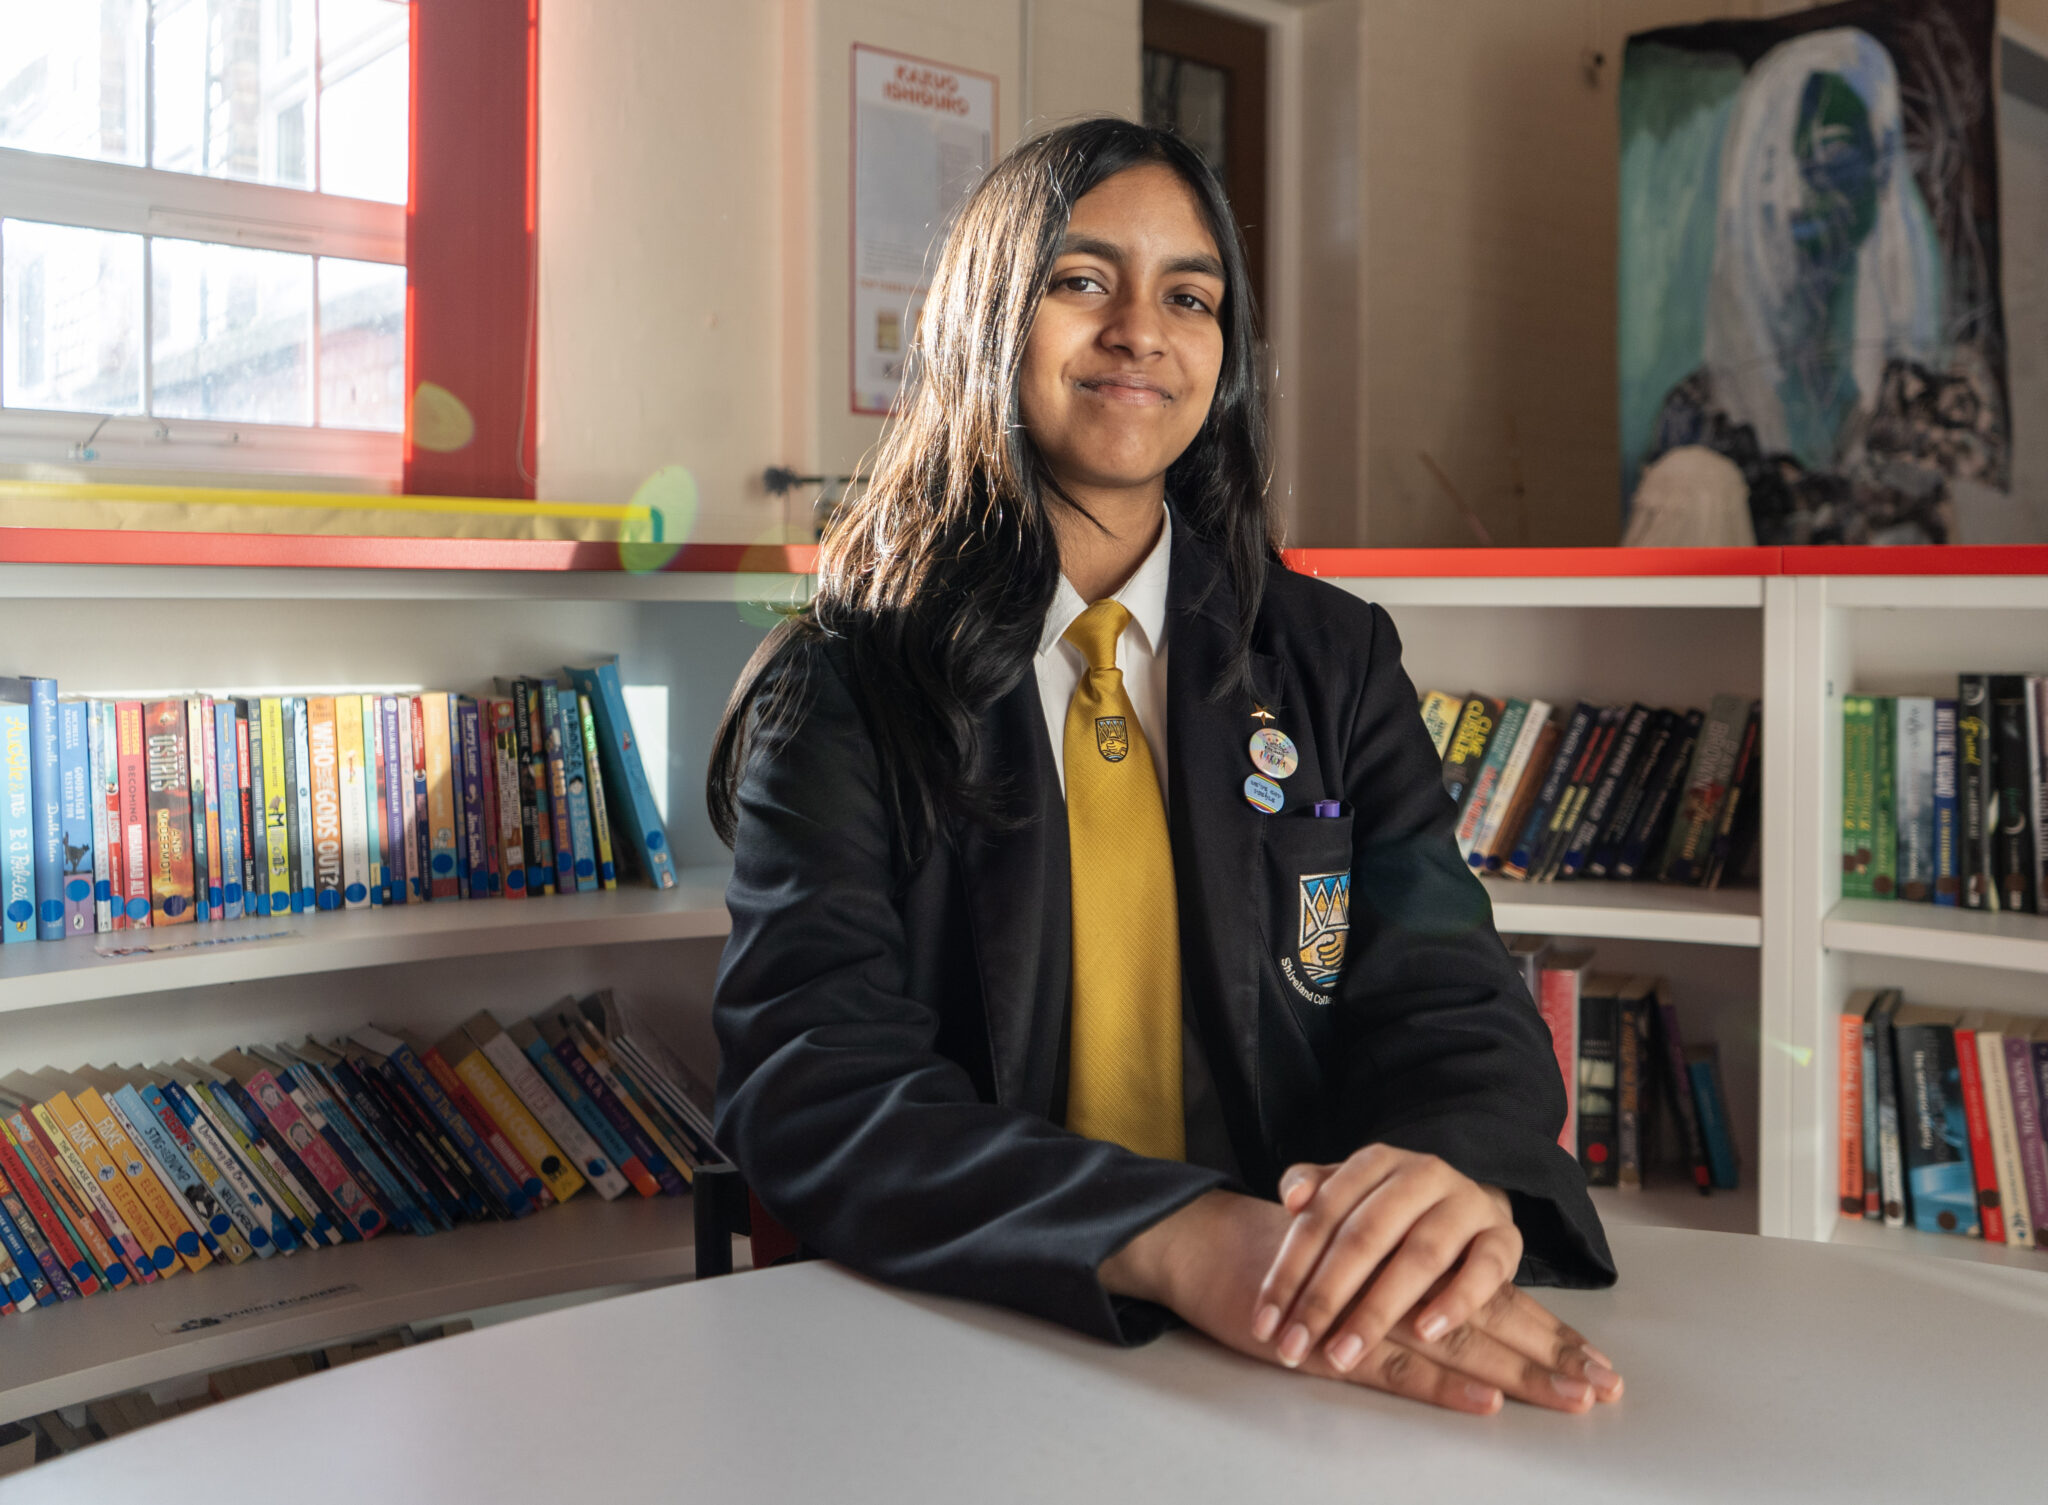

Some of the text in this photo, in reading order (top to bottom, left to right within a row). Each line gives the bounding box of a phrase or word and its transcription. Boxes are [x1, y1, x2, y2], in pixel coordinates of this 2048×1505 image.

[882, 81, 970, 115] ISHIGURO
[894, 65, 959, 93] KAZUO
[64, 709, 72, 749] MAGORIAN
[71, 709, 79, 746] MICHELLE
[121, 710, 130, 755] ALEXANDER
[131, 709, 139, 754] PATTERSON
[311, 720, 333, 766] WHO
[387, 714, 396, 760] BENJAMIN
[1448, 698, 1485, 766] CUSSLER
[1468, 715, 1493, 758] CLIVE
[148, 733, 179, 791] OSIRIS
[1694, 719, 1730, 792] BROWN
[1717, 738, 1737, 779] DAN
[64, 770, 74, 818] MISTER TOM
[73, 766, 84, 820] GOODNIGHT
[180, 776, 186, 785] OF
[390, 763, 398, 813] ZEPHANIAH
[127, 765, 144, 895] BECOMING MUHAMMAD ALI
[316, 790, 337, 837] GODS
[172, 829, 183, 861] ANDY
[223, 827, 238, 875] Jacqueline
[319, 840, 339, 885] OUT?
[469, 832, 483, 868] Smith
[8, 854, 30, 902] Palaci
[1281, 957, 1336, 1006] Shireland Colle
[463, 1058, 516, 1120] HARLAN
[9, 1114, 57, 1179] Dotty DETECTIVE
[66, 1118, 98, 1154] FAKE
[95, 1115, 126, 1150] FAKE
[157, 1104, 192, 1146] FREDDY
[195, 1123, 228, 1162] Dreaming
[58, 1139, 97, 1193] THE SUITCASE KID
[143, 1124, 191, 1185] STIG DUMP
[93, 1193, 118, 1225] Jacqueline
[111, 1182, 129, 1203] ELE
[123, 1199, 157, 1244] FOUNTAIN
[139, 1177, 185, 1237] ELE FOUNTAIN
